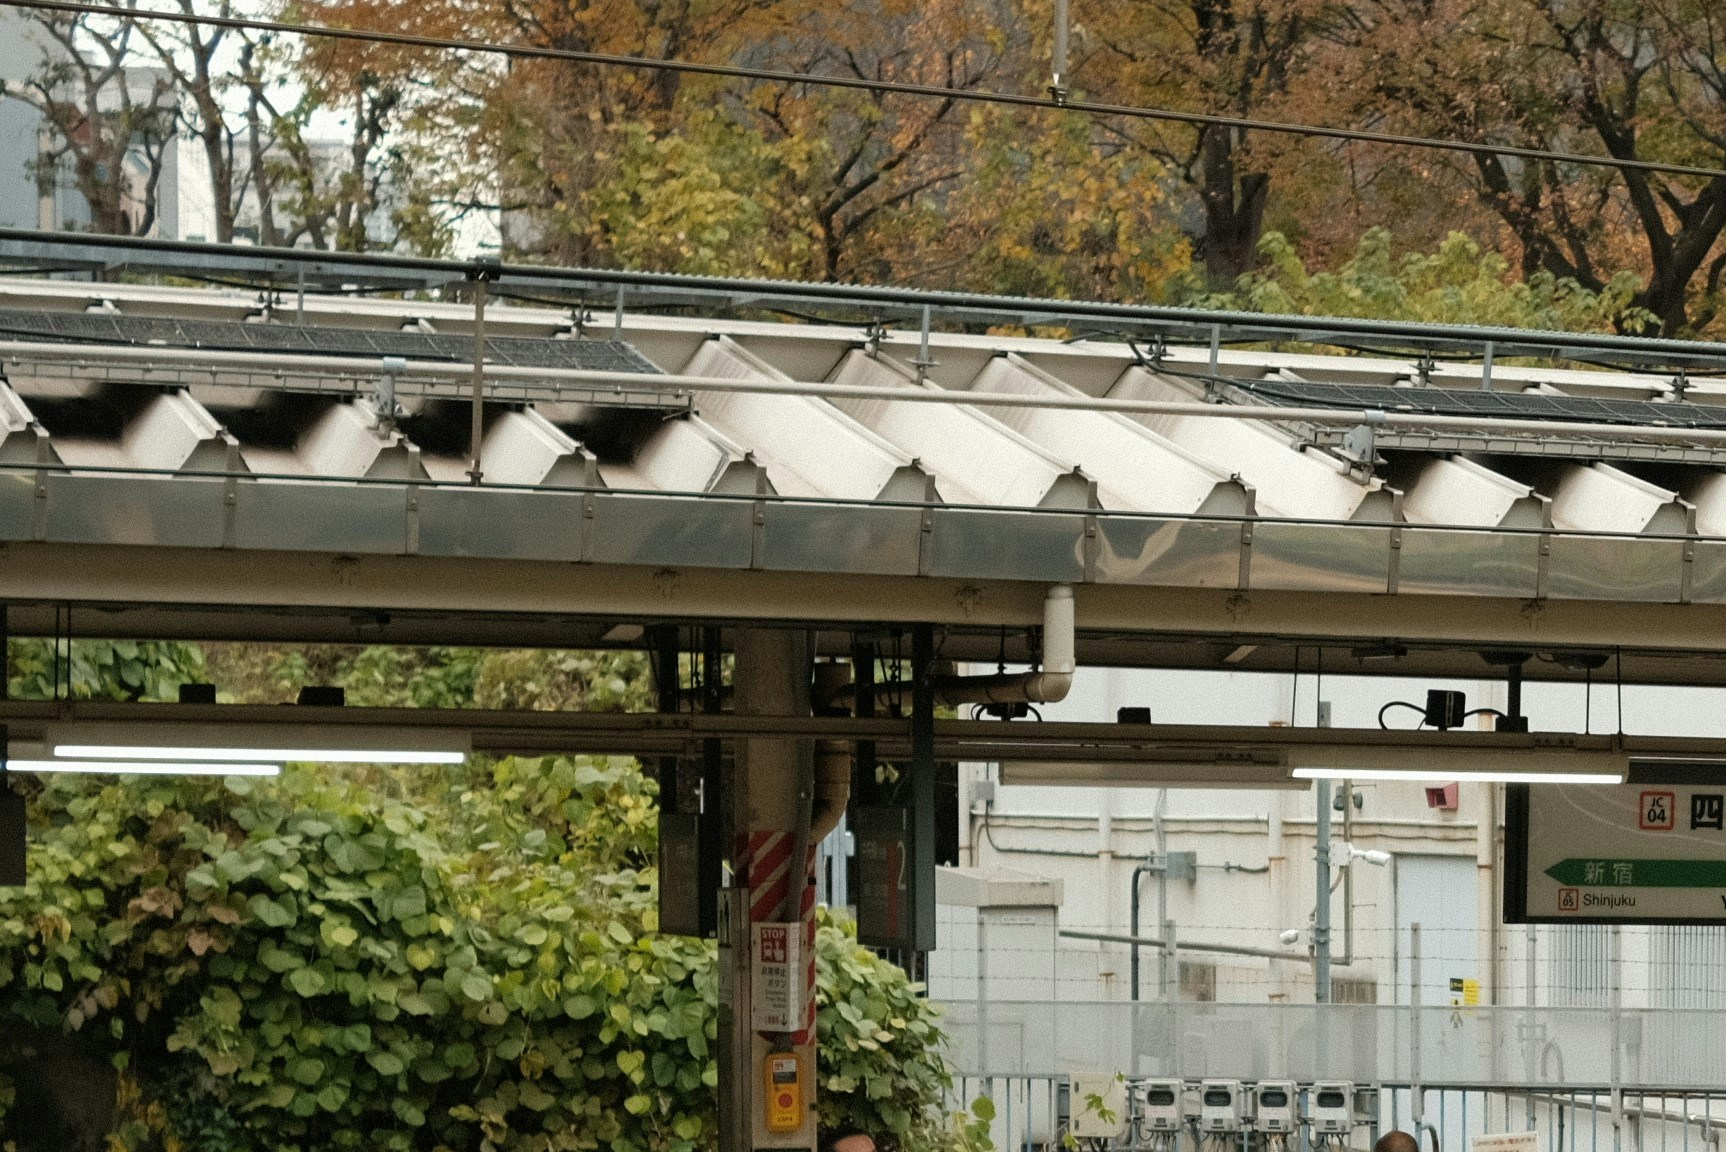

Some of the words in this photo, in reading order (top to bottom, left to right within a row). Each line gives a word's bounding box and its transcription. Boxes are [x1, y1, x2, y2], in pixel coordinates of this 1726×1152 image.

[1651, 796, 1664, 808] JC
[1647, 808, 1667, 823] 04
[896, 840, 907, 890] 2
[1583, 862, 1633, 885] 新宿
[1583, 893, 1636, 909] Shinjuku
[762, 929, 785, 939] STOP
